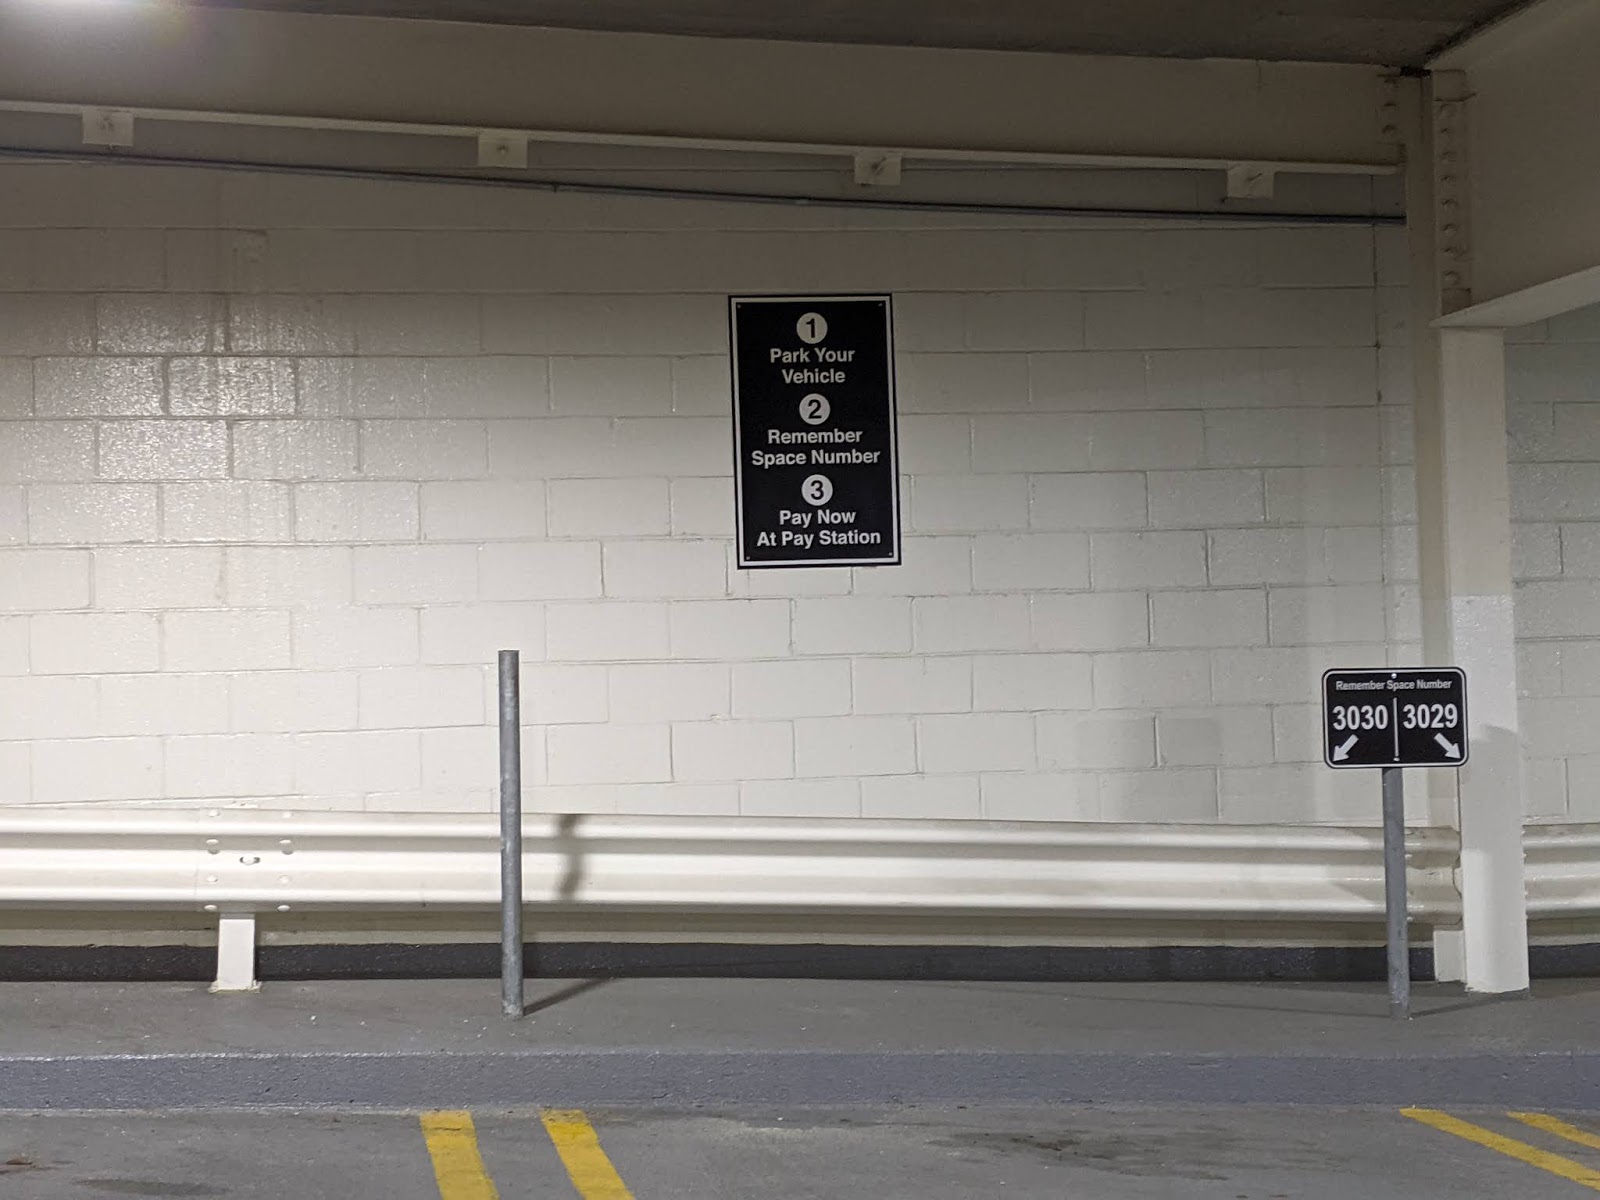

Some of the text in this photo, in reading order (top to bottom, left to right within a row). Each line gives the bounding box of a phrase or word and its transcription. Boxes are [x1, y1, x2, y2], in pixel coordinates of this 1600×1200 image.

[805, 317, 817, 340] 1
[769, 348, 855, 363] Park Your
[782, 368, 846, 384] Vehicle
[806, 398, 823, 420] 2
[767, 428, 863, 444] Remember
[751, 449, 881, 469] Space Number
[809, 479, 826, 501] 3
[779, 509, 857, 528] Pay Now
[756, 529, 882, 550] At Pay Station
[1335, 679, 1453, 692] Remember Space Number
[1332, 704, 1389, 730] 3030
[1402, 703, 1459, 729] 3029
